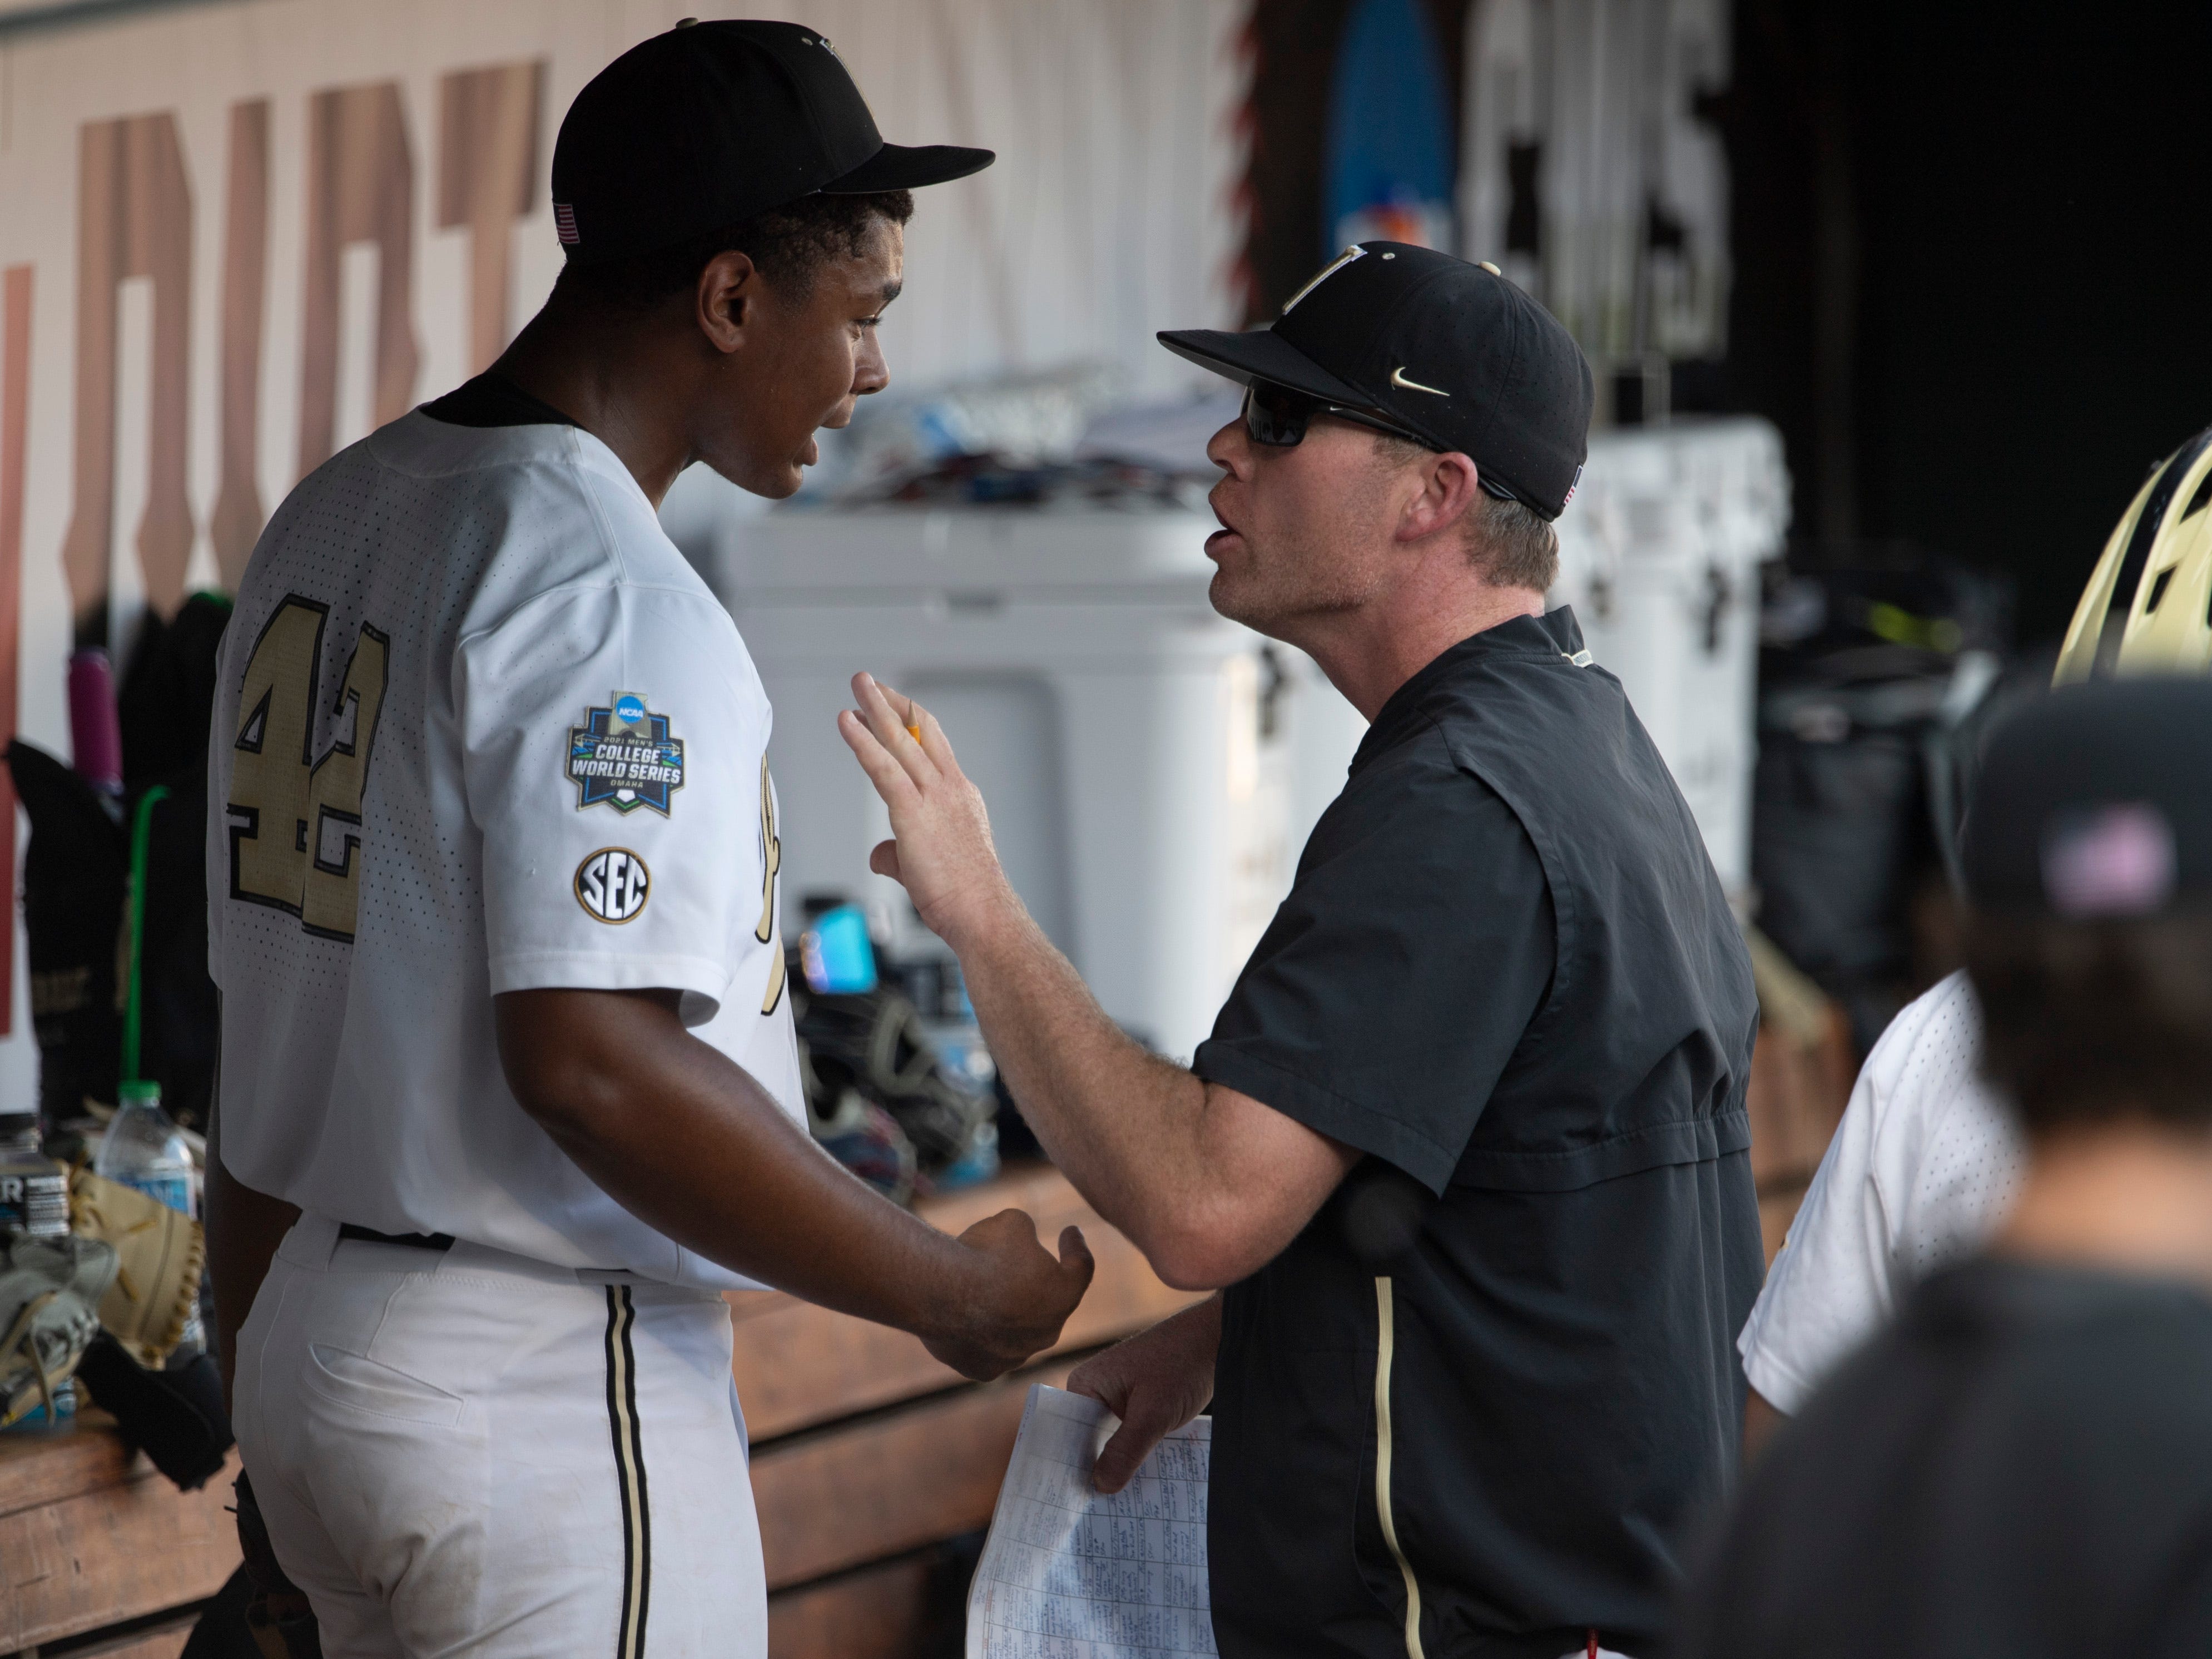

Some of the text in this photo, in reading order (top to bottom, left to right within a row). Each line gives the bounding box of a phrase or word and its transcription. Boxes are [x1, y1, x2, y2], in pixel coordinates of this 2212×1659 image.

[618, 707, 644, 718] NCAA
[627, 738, 653, 747] MEN'S
[596, 744, 661, 765] COLLEGE
[226, 592, 390, 944] 42
[572, 760, 681, 784] WORLD SERIES
[610, 779, 644, 788] OMAHA
[582, 851, 647, 919] SEC
